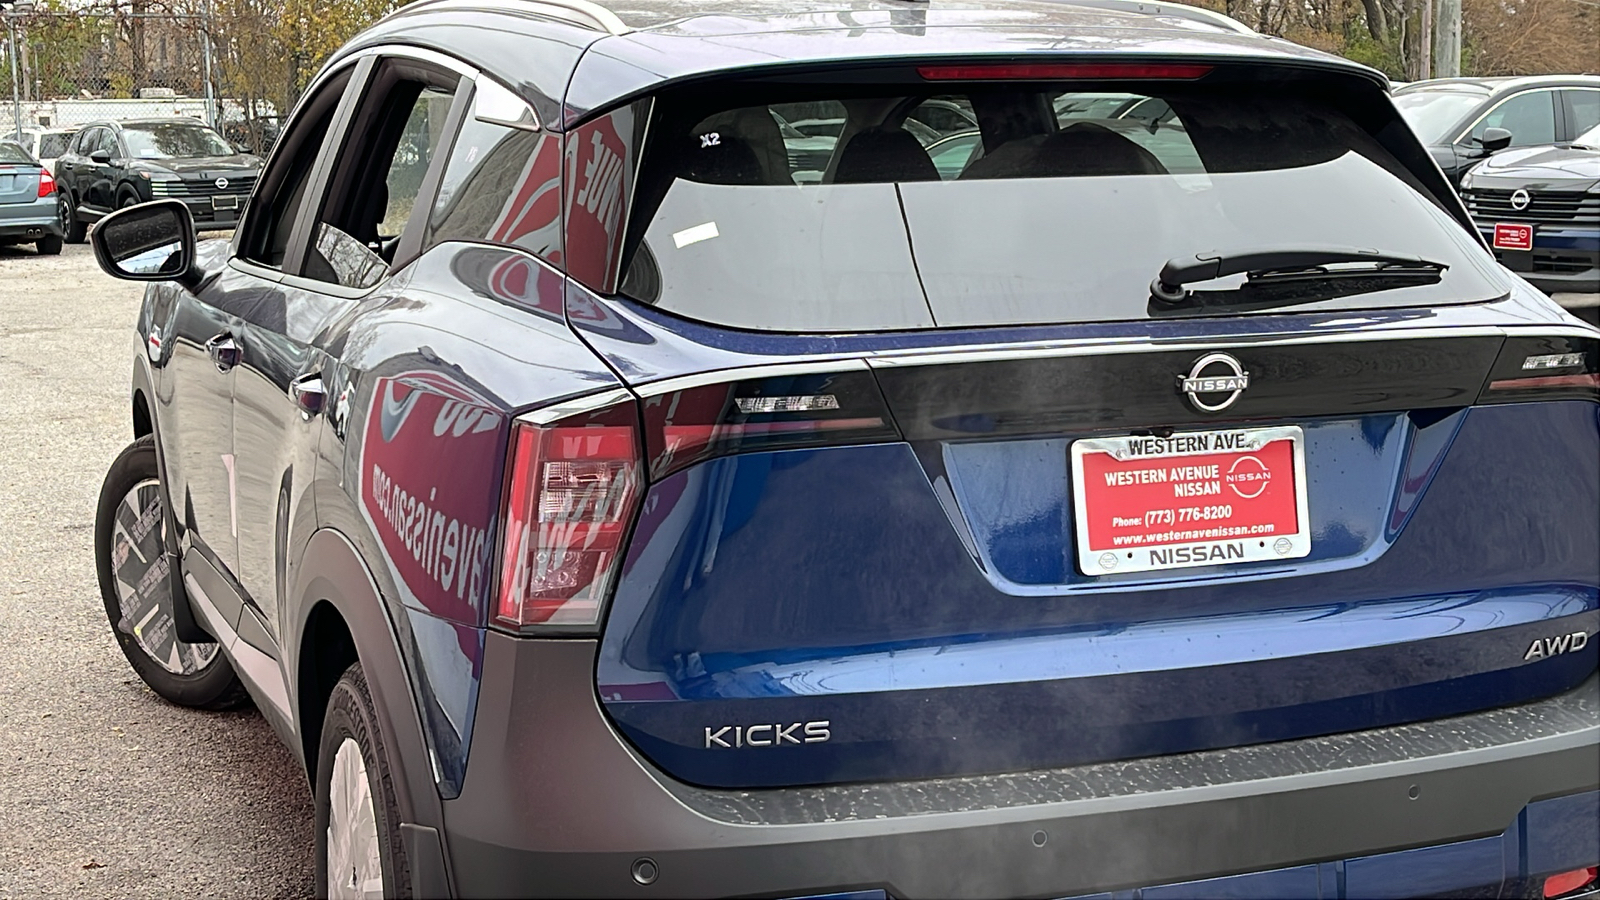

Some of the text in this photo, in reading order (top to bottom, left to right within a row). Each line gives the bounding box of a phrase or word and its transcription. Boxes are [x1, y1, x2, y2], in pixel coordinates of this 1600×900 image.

[1184, 378, 1248, 391] NISSAN
[1129, 436, 1208, 455] WESTERN
[1105, 465, 1219, 486] WESTERN AVENUE
[1226, 472, 1271, 482] NISSAN
[1174, 481, 1221, 497] NISSAN
[1112, 505, 1232, 528] Phone: (773) 776-8200
[1113, 524, 1275, 545] www.westernavenissan.com
[1150, 542, 1245, 565] NISSAN
[1524, 631, 1588, 660] AWD
[705, 721, 831, 748] KICKS
